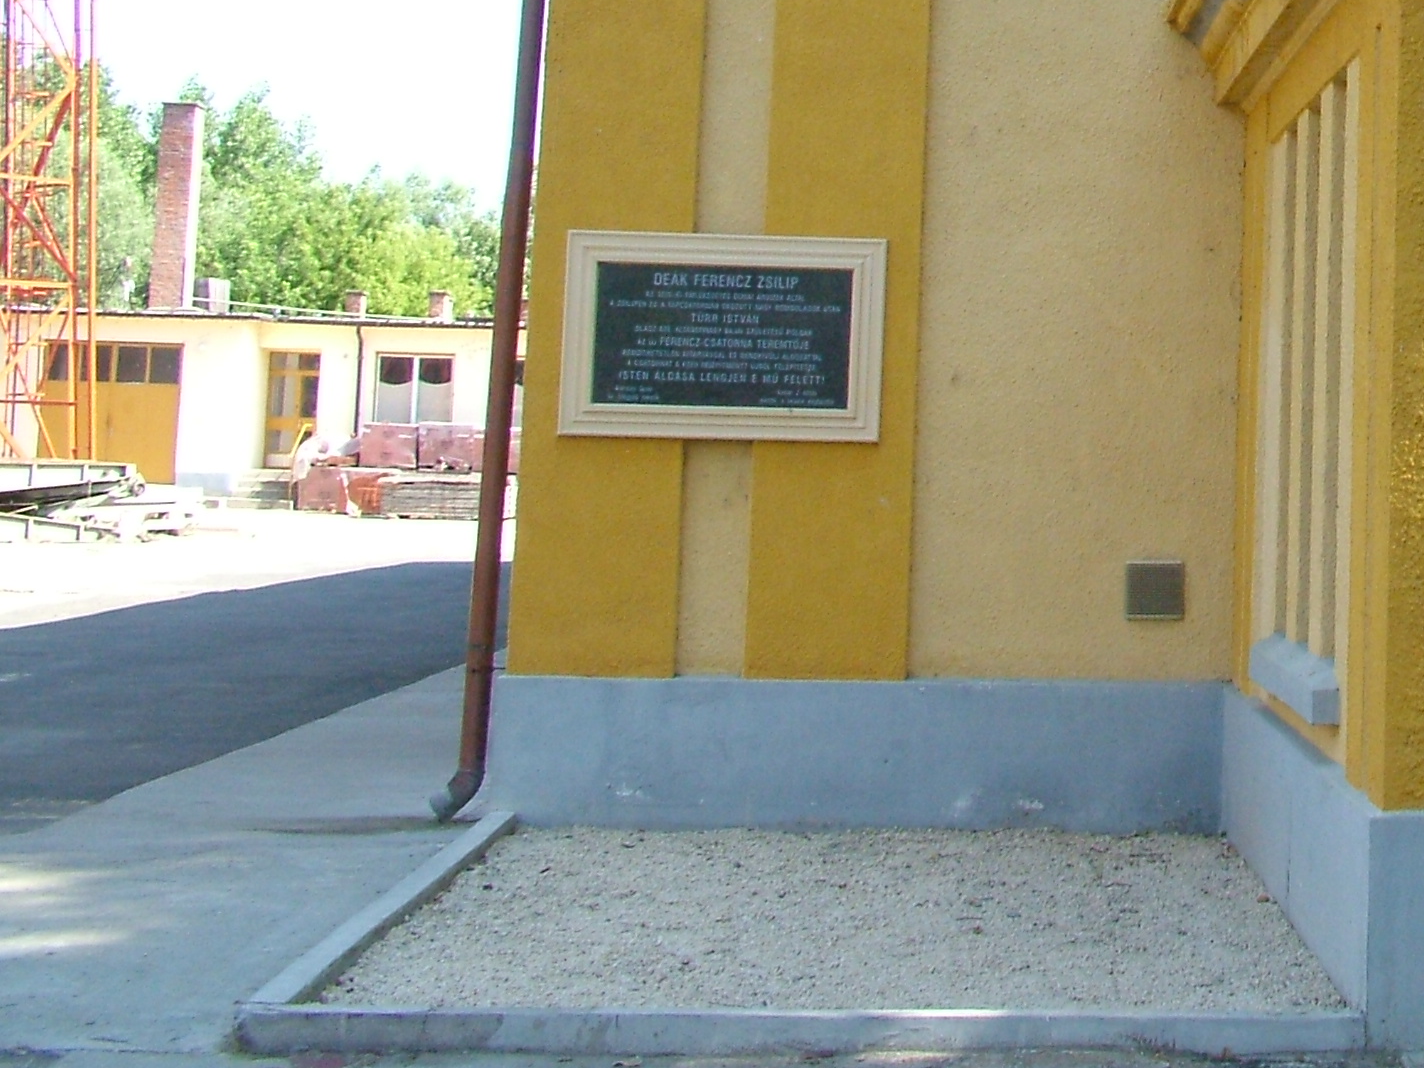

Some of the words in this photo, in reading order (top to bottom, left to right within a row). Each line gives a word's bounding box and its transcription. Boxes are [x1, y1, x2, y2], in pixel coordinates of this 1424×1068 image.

[694, 273, 752, 288] FERENCZ
[756, 275, 799, 289] ZSILIP
[618, 370, 649, 381] ISTEN
